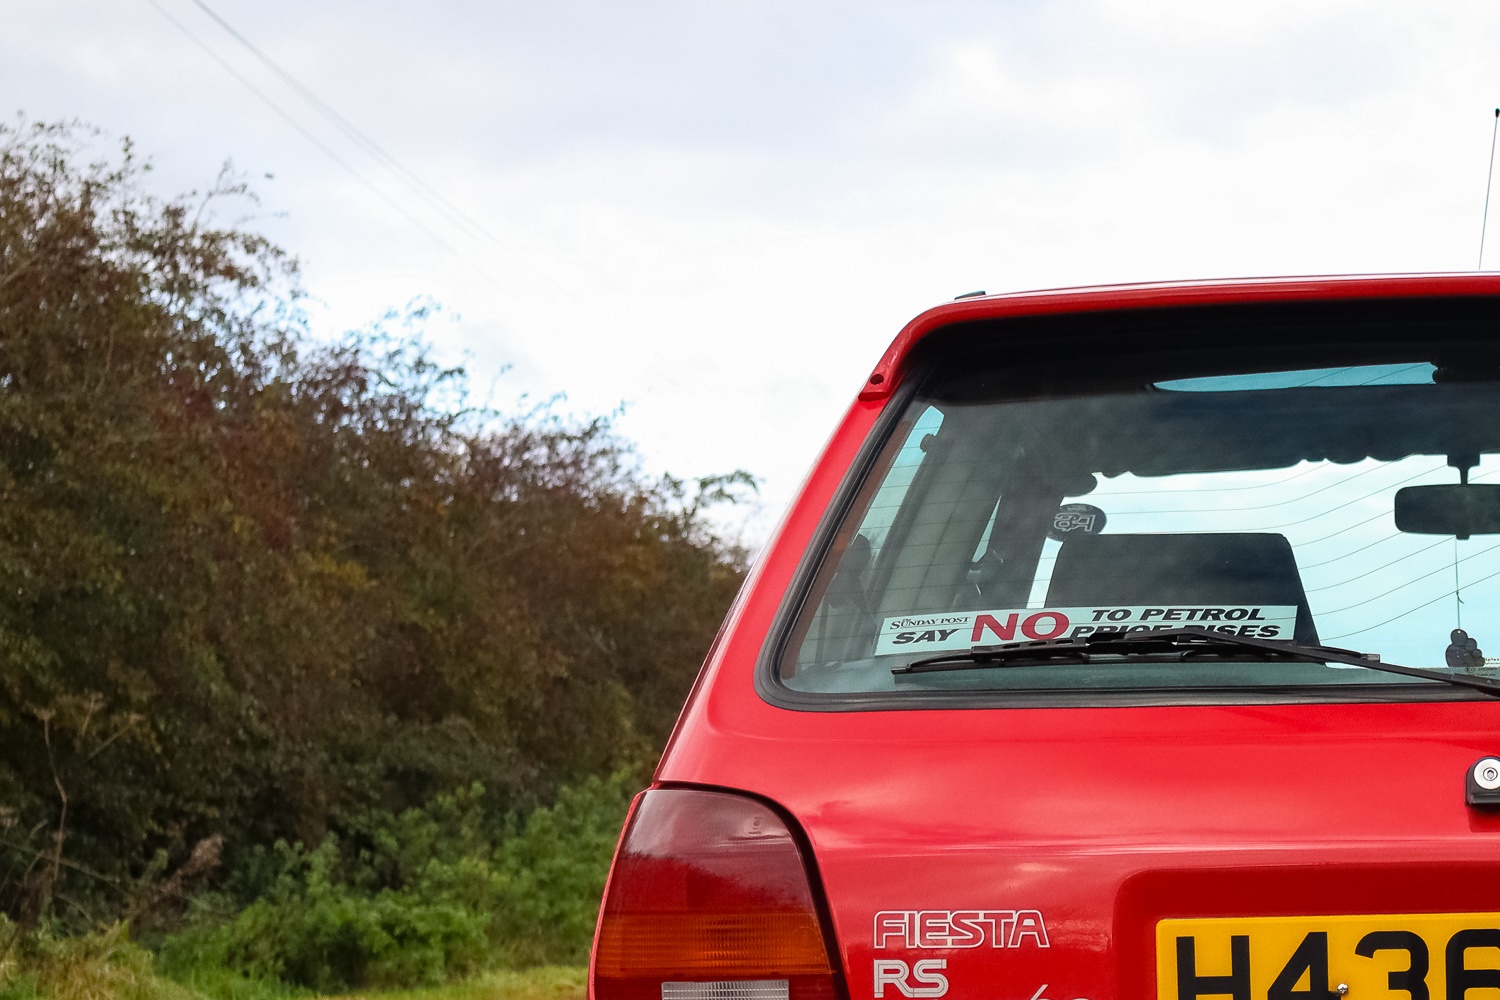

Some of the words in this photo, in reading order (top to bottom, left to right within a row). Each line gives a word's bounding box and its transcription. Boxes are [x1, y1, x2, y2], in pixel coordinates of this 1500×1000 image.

[890, 618, 938, 630] SUNDAY
[941, 616, 970, 624] POST
[892, 628, 960, 645] SAY
[971, 611, 1070, 642] NO
[1091, 608, 1132, 622] TO
[1139, 608, 1266, 621] PETROL
[873, 910, 1051, 949] FIESTA
[873, 958, 949, 999] RS
